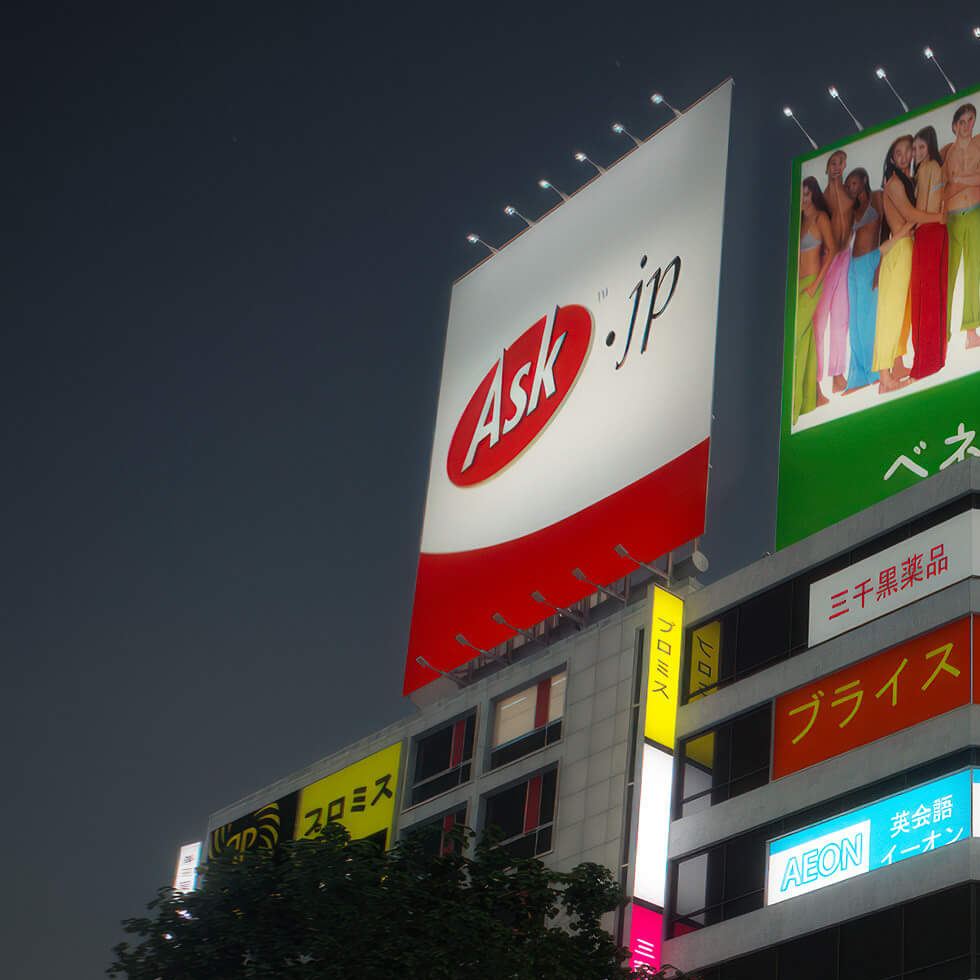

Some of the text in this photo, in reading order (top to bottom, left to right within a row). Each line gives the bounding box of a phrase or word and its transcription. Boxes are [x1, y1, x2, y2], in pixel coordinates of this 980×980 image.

[890, 794, 953, 838] 英会話
[780, 832, 864, 892] AEON
[880, 827, 964, 865] イーオン
